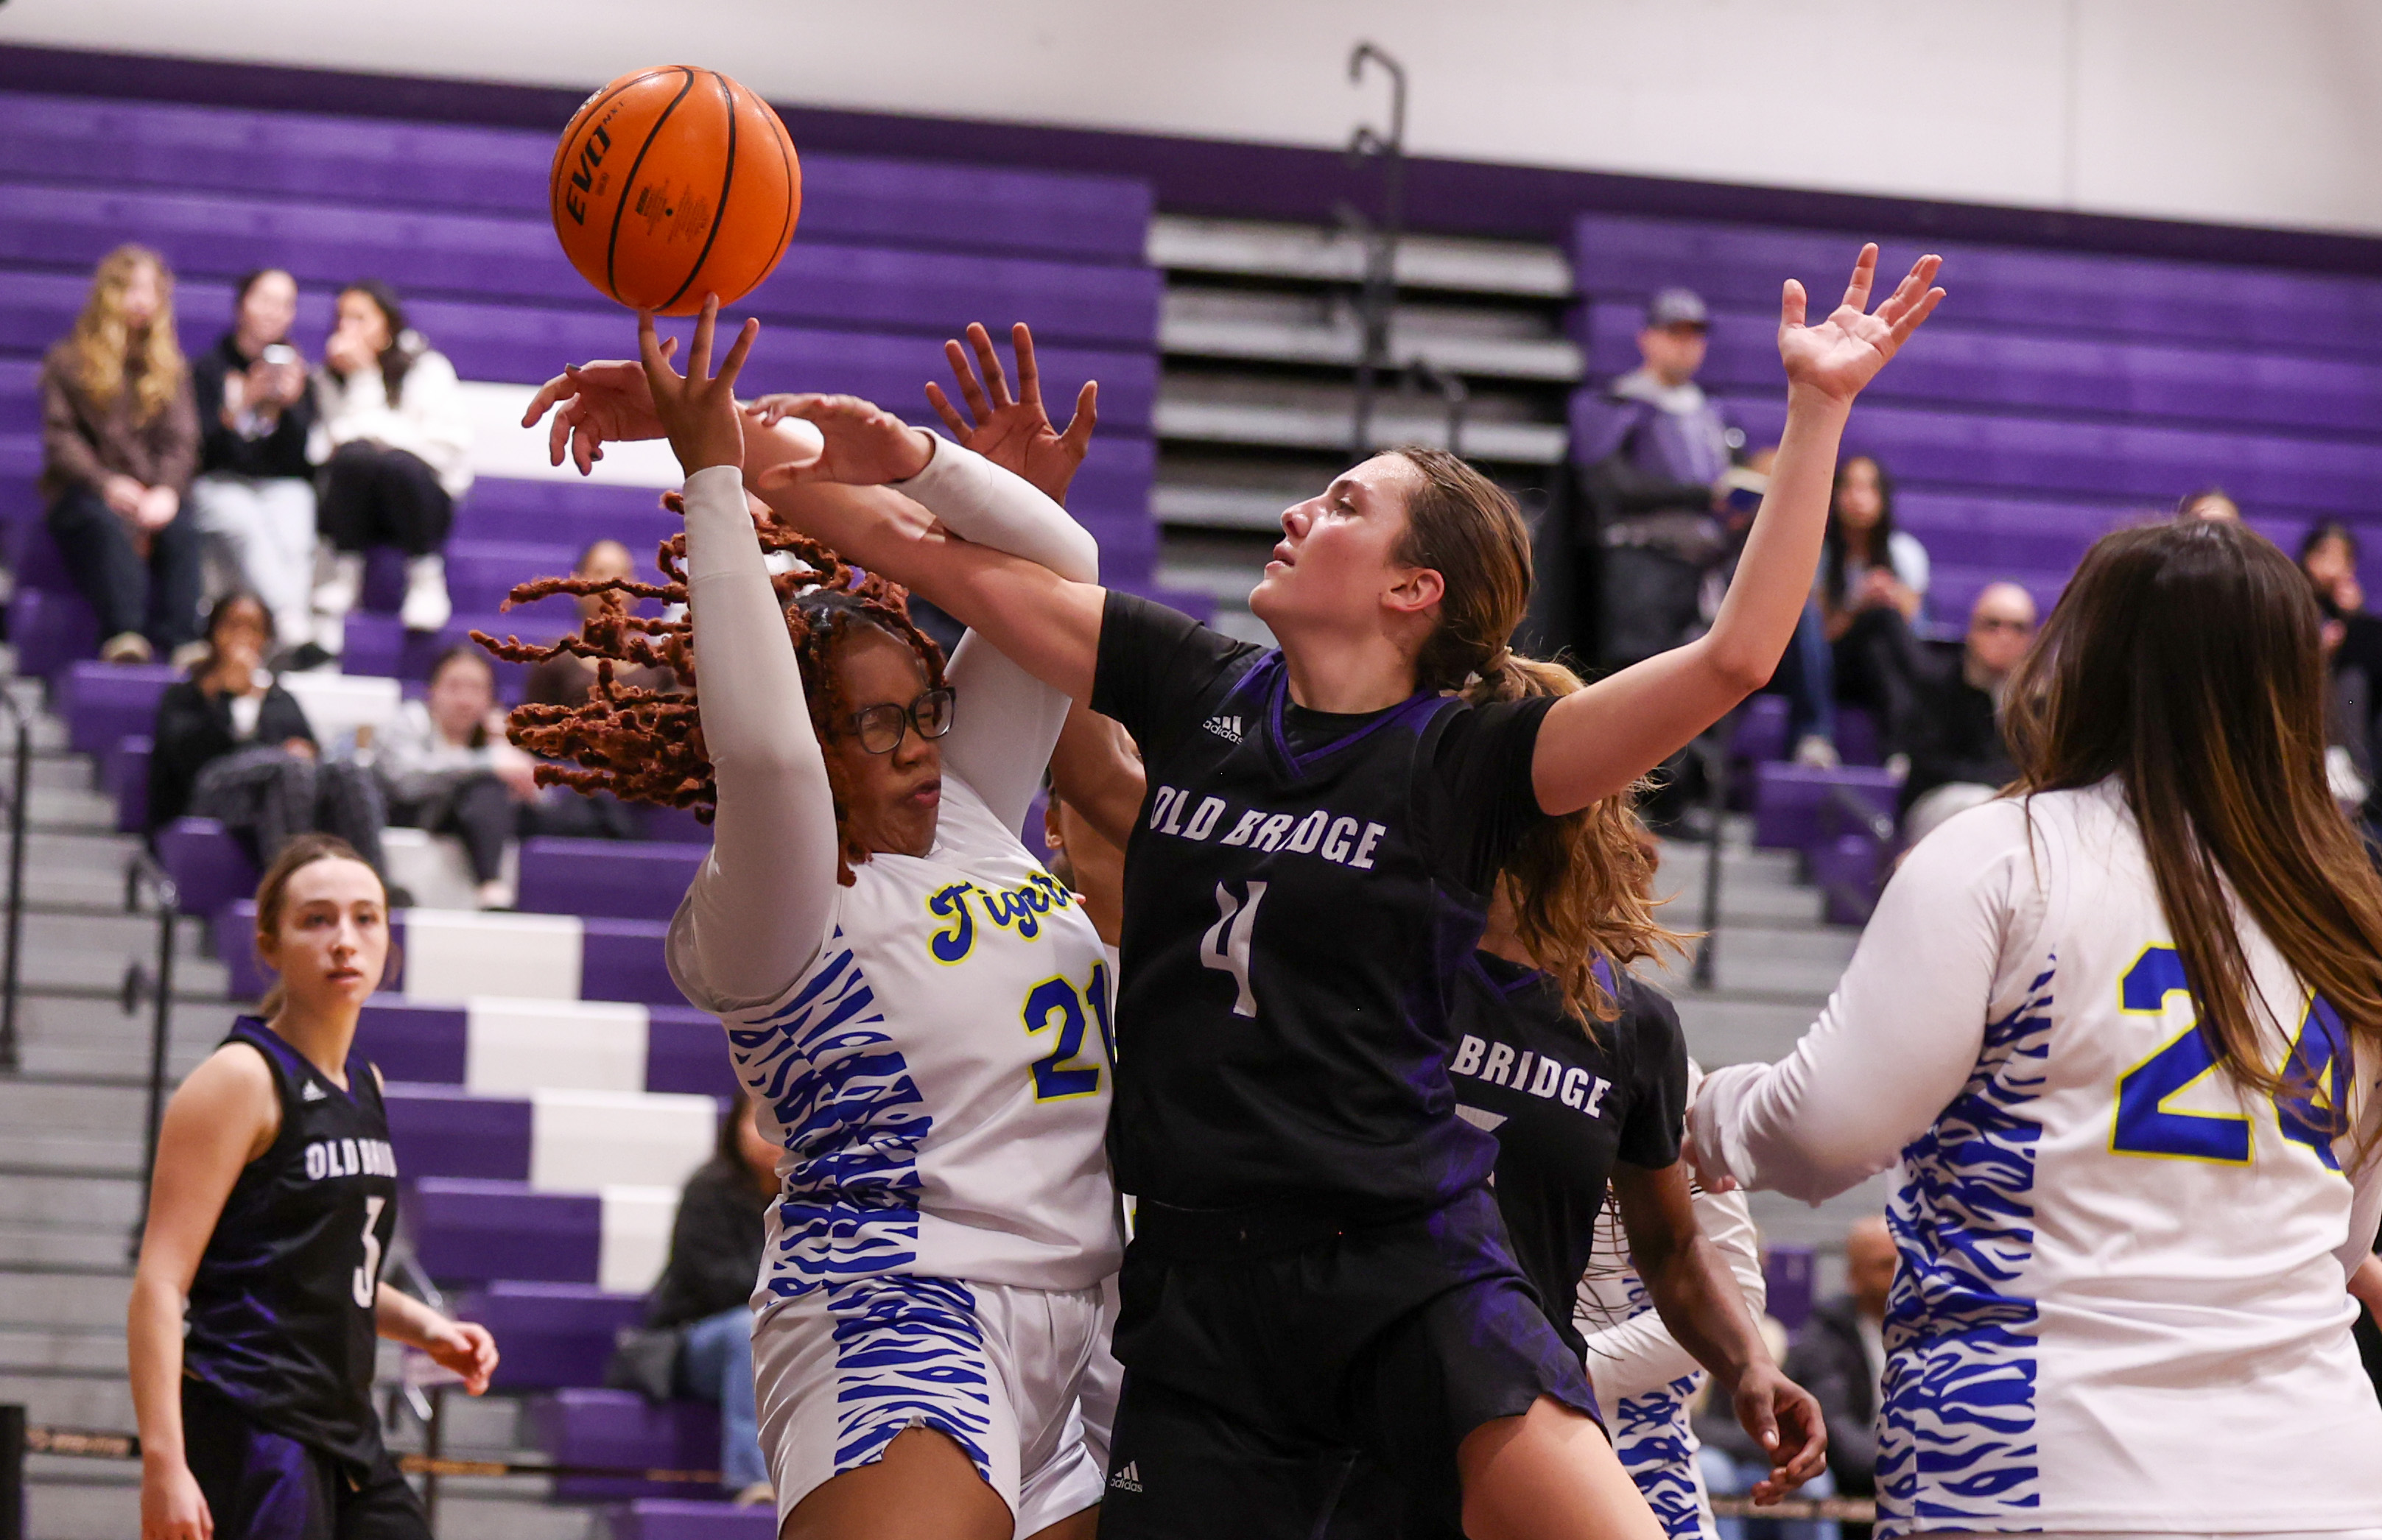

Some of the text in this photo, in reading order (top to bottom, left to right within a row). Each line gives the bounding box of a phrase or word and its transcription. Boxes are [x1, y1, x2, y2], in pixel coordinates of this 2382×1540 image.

[567, 125, 611, 225] EVO
[1203, 720, 1243, 745] adidas
[1150, 785, 1226, 841] OLD
[928, 872, 1075, 964] Tiger
[1200, 880, 1268, 1019] 4
[1022, 959, 1117, 1102] 21
[1449, 1033, 1612, 1119] BRIDGE
[306, 1137, 361, 1180] OLD
[352, 1195, 386, 1309] 3
[1110, 1478, 1142, 1492] adidas
